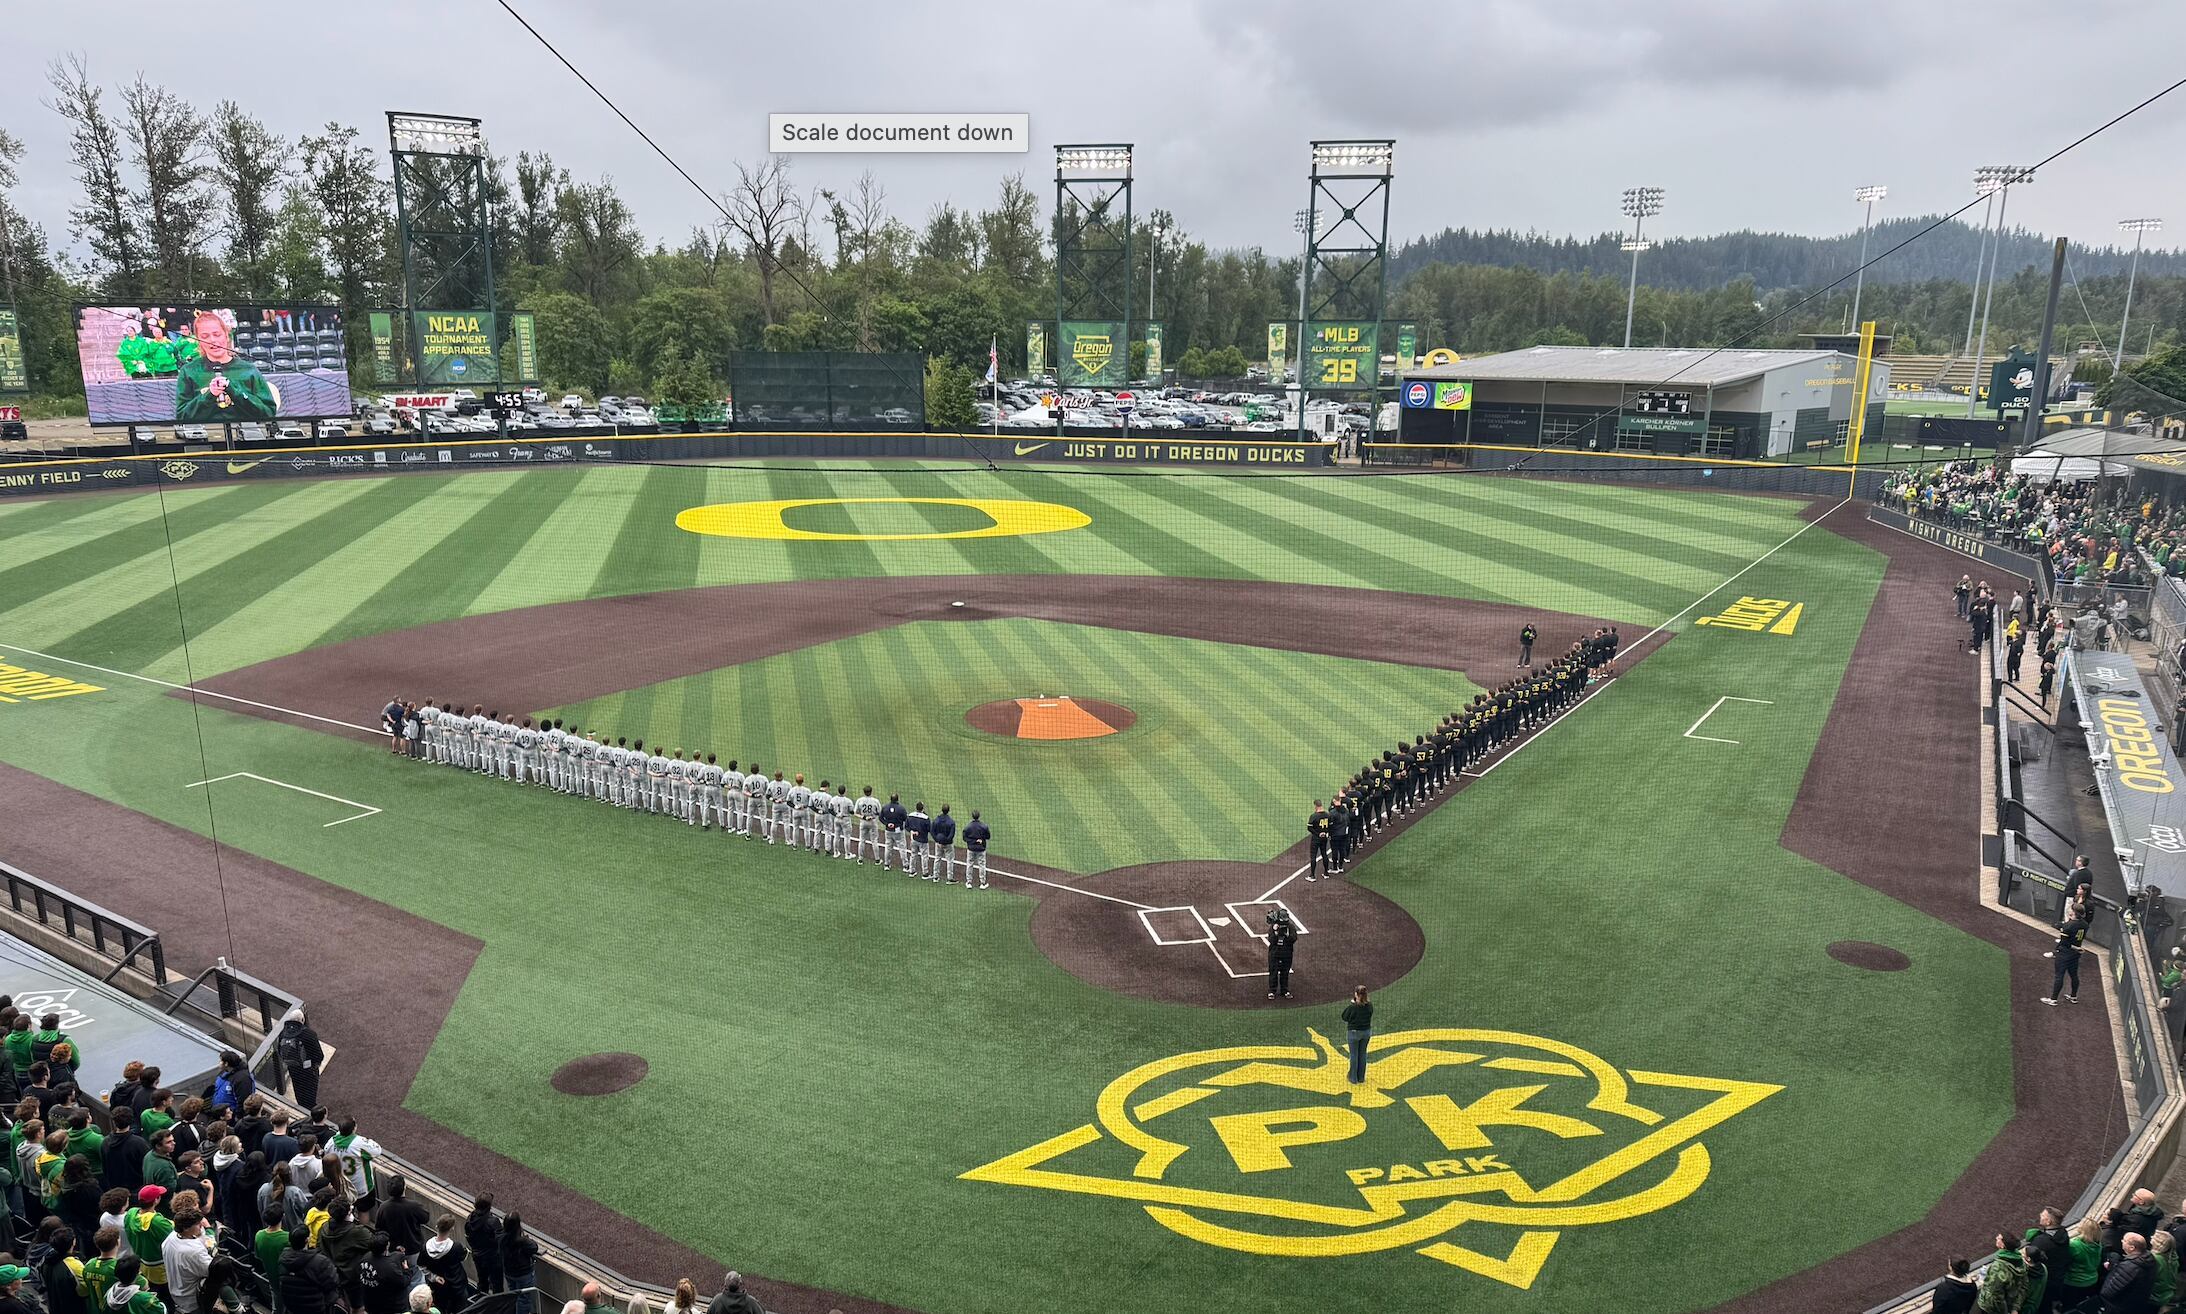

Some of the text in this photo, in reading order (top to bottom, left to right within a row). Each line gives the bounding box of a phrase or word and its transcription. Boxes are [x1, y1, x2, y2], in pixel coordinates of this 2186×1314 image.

[428, 316, 480, 333] NCAA
[424, 335, 487, 344] TOURNAMENT
[1324, 327, 1359, 343] MLB
[423, 346, 491, 354] APPEARANCES
[1074, 341, 1112, 357] Oregon
[1322, 358, 1357, 383] 39
[495, 394, 522, 407] 4:55
[1064, 444, 1305, 463] JUST DO IT OREGON DUCKS
[41, 471, 81, 484] FIELD
[1909, 519, 1984, 557] MIGHTY OREGON
[2098, 699, 2175, 794] OREGON
[652, 763, 660, 772] 31
[672, 766, 681, 775] 32
[706, 772, 715, 782] 13
[751, 781, 760, 790] 10
[1345, 1153, 1512, 1186] PARK
